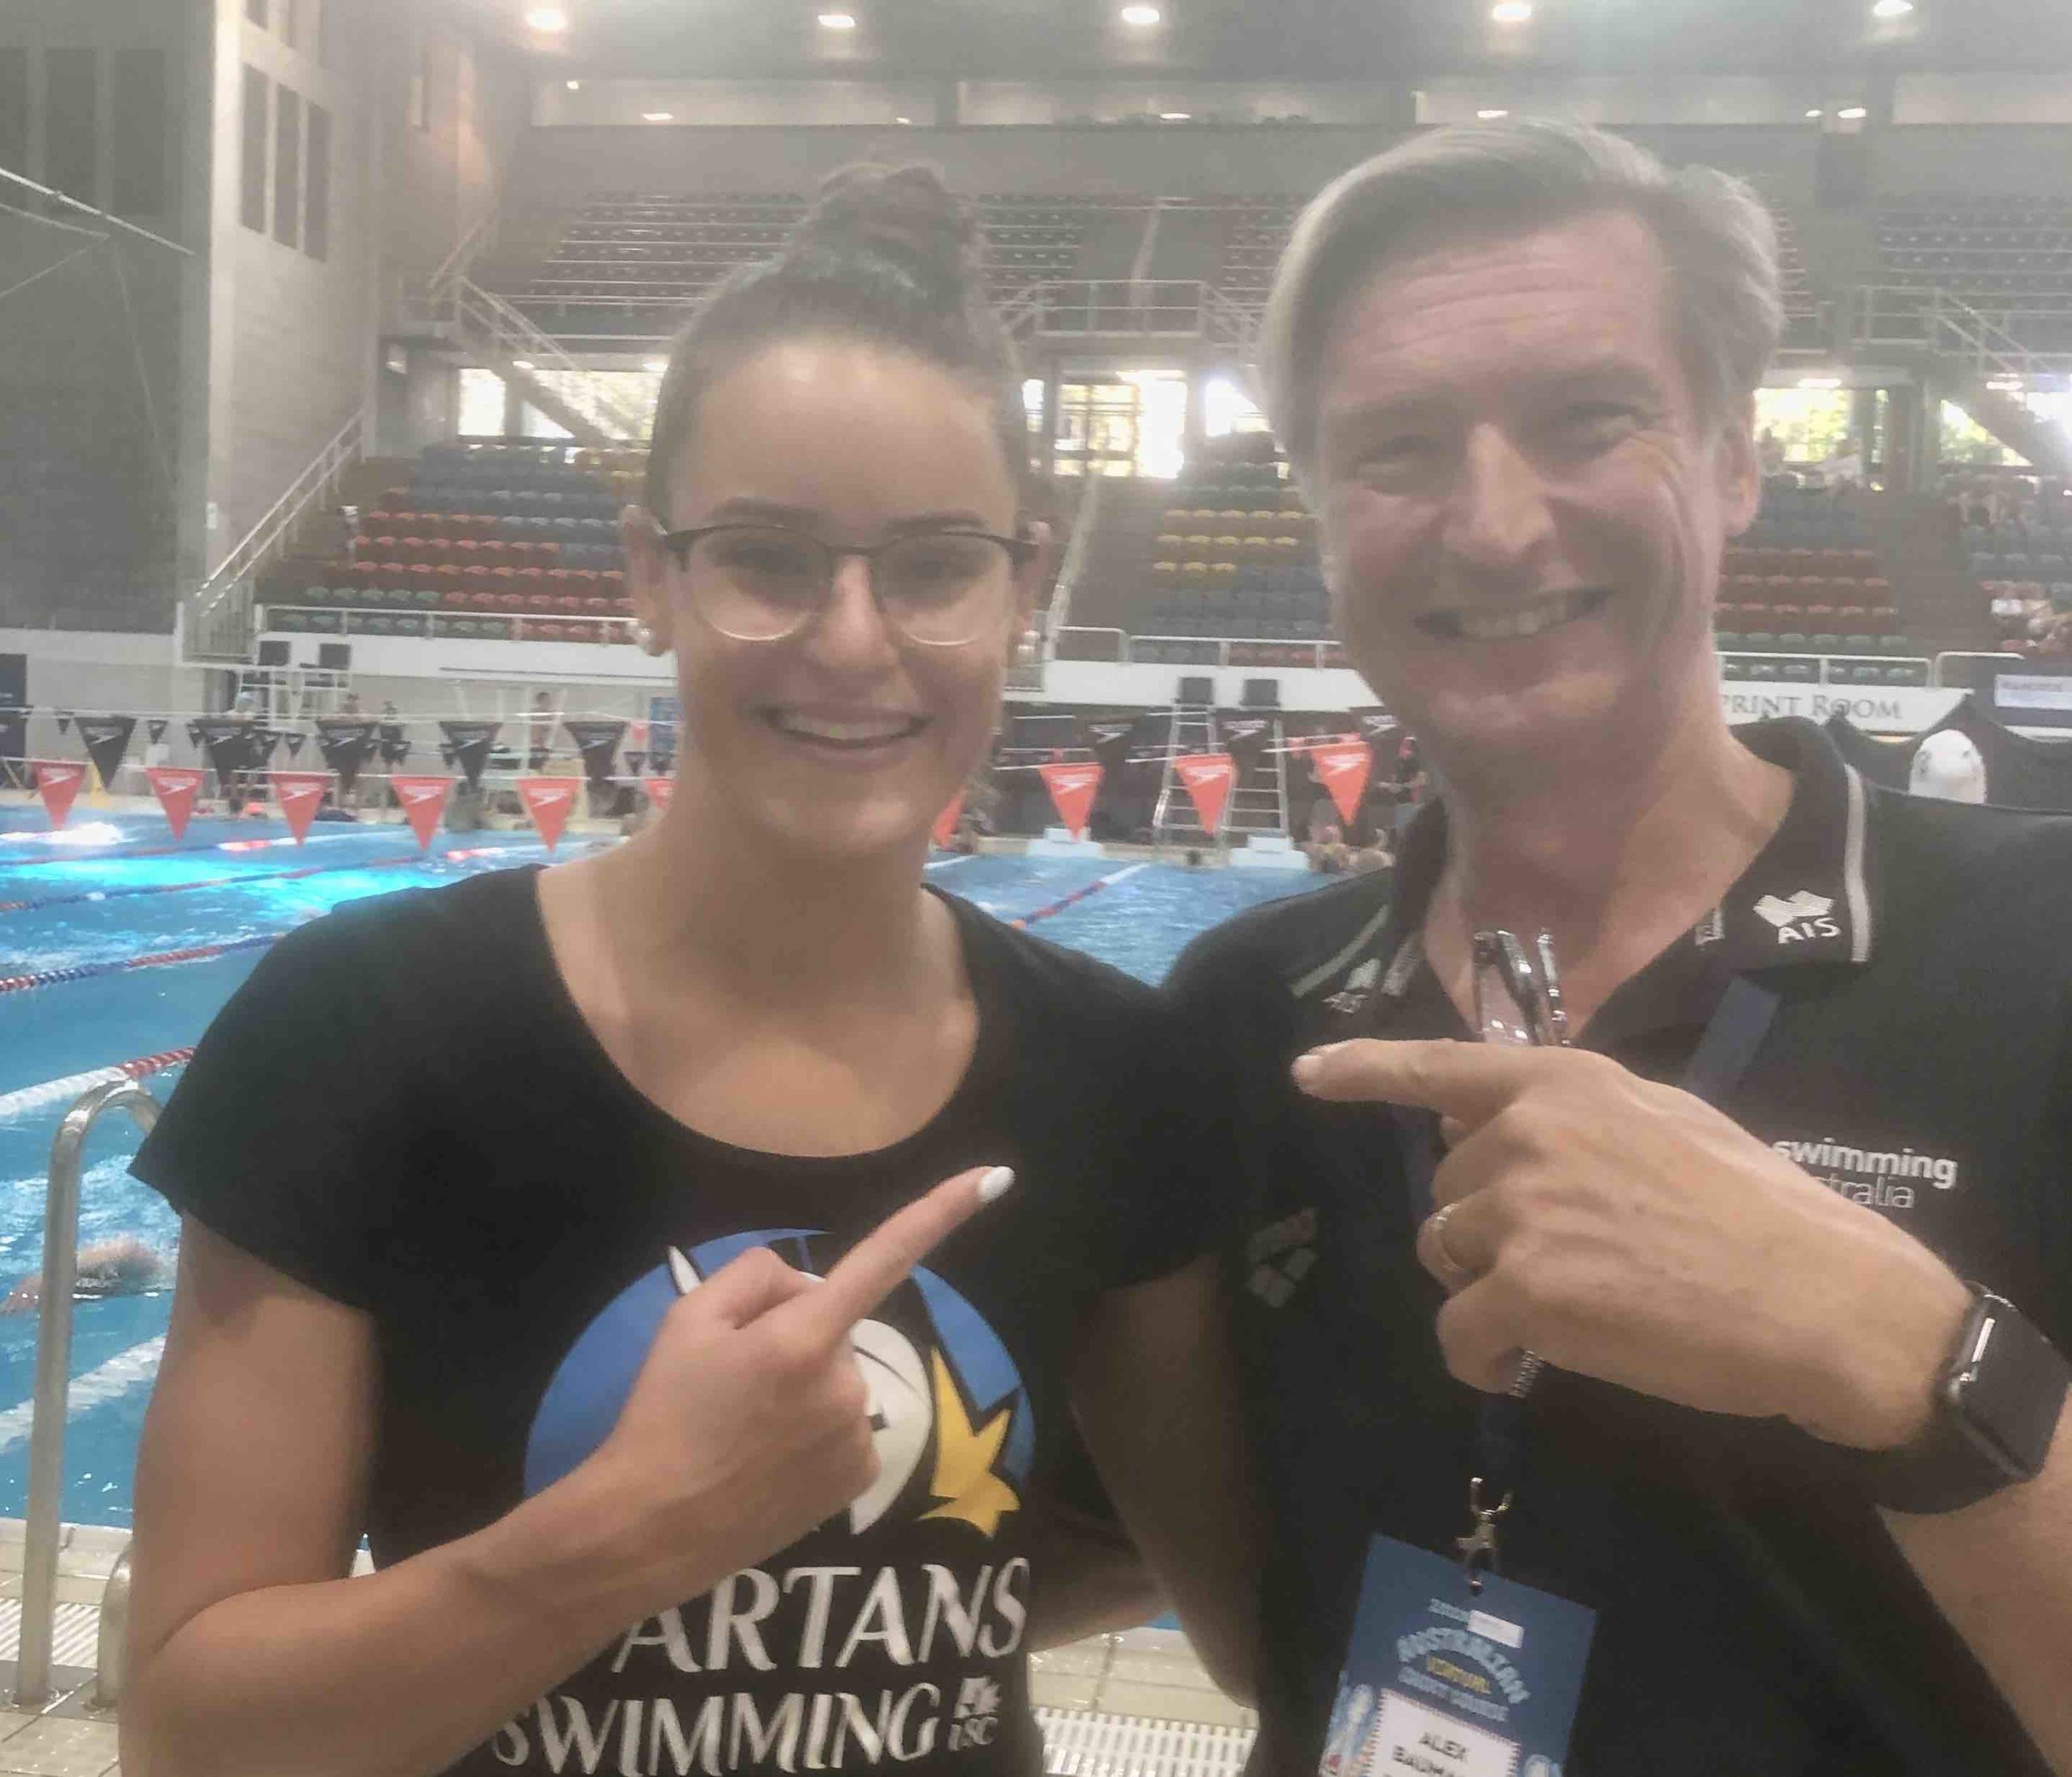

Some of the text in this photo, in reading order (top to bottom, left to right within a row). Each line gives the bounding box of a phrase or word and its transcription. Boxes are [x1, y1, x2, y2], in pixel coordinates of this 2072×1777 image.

[1811, 694, 1902, 719] ROOM
[1778, 917, 1841, 944] AIS
[1773, 1137, 1959, 1189] swimming
[1814, 1173, 1915, 1209] tralia
